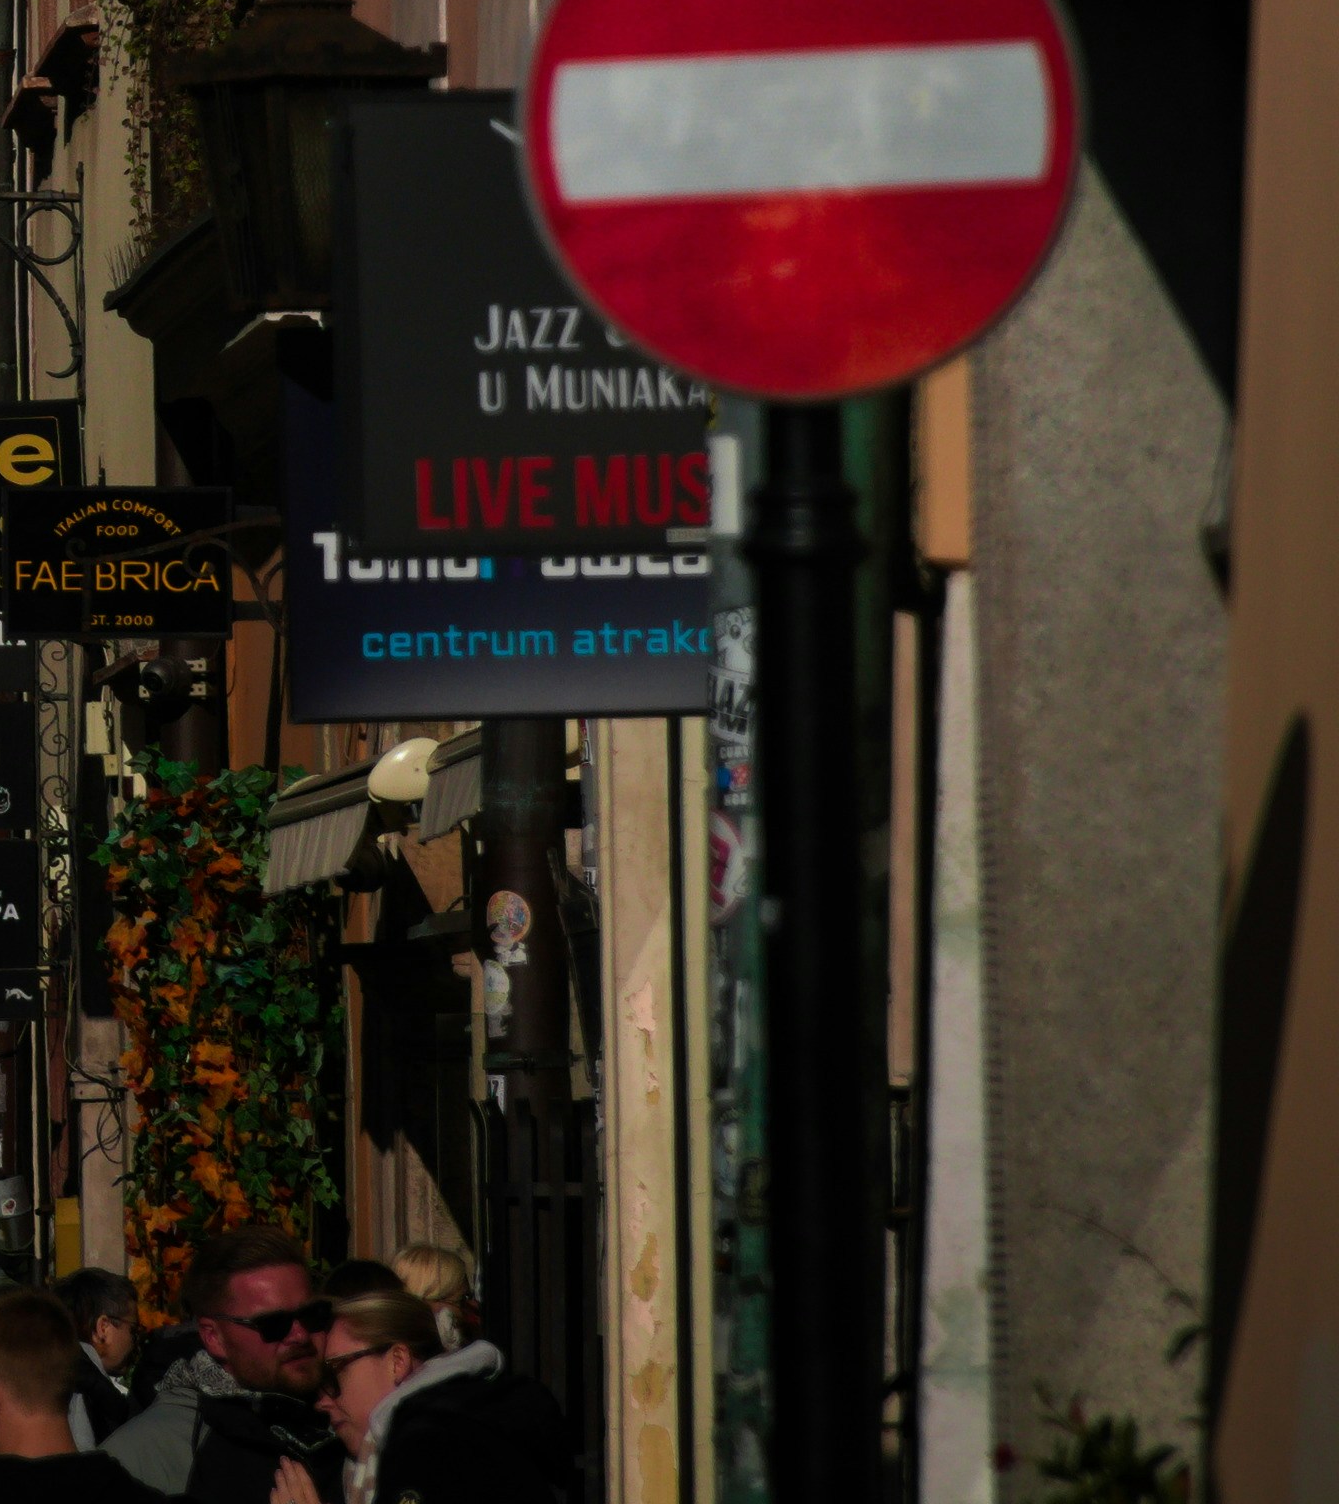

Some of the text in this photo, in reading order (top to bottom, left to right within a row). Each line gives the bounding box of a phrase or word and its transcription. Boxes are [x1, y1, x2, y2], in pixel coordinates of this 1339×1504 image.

[474, 303, 582, 353] JAZZ
[414, 452, 710, 530] LIVE MUS
[53, 498, 182, 537] ITALIAN COMFORT
[96, 524, 139, 537] FOOD
[88, 613, 154, 626] ST. 2000
[361, 623, 557, 661] centrum
